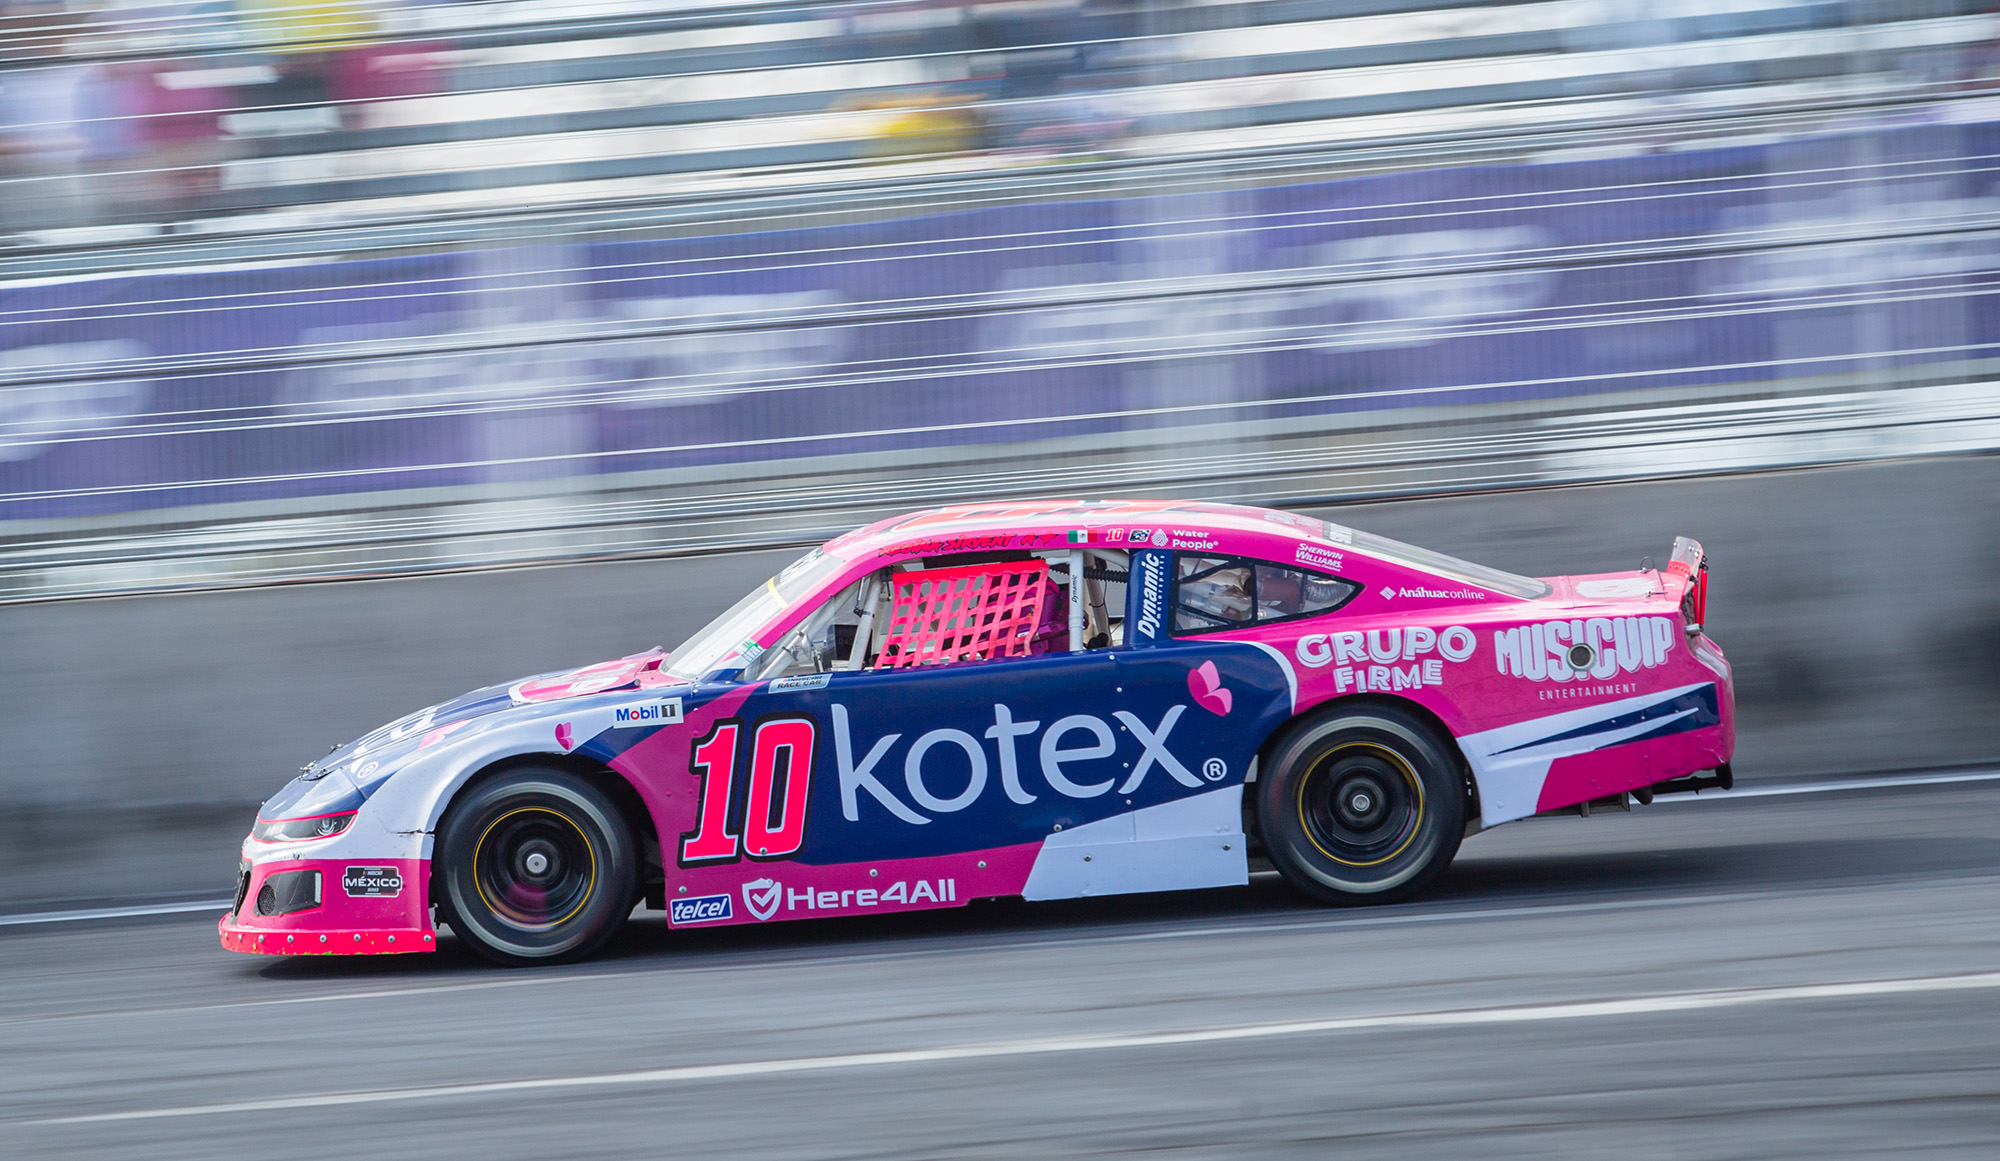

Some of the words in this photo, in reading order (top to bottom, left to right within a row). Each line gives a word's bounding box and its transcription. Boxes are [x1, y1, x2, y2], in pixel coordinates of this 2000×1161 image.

[1106, 528, 1124, 542] 10
[1172, 529, 1209, 538] Water
[1298, 543, 1343, 560] SHERWIN
[1138, 553, 1160, 639] Dynamic
[1296, 626, 1477, 667] GRUPO
[1332, 660, 1444, 693] FIRME
[1539, 683, 1637, 700] ENTERTAINMENT
[616, 706, 658, 722] Mobil
[681, 717, 815, 863] 10
[345, 876, 400, 887] MÉXICO
[787, 878, 956, 911] Here4All
[673, 897, 728, 920] telcel
